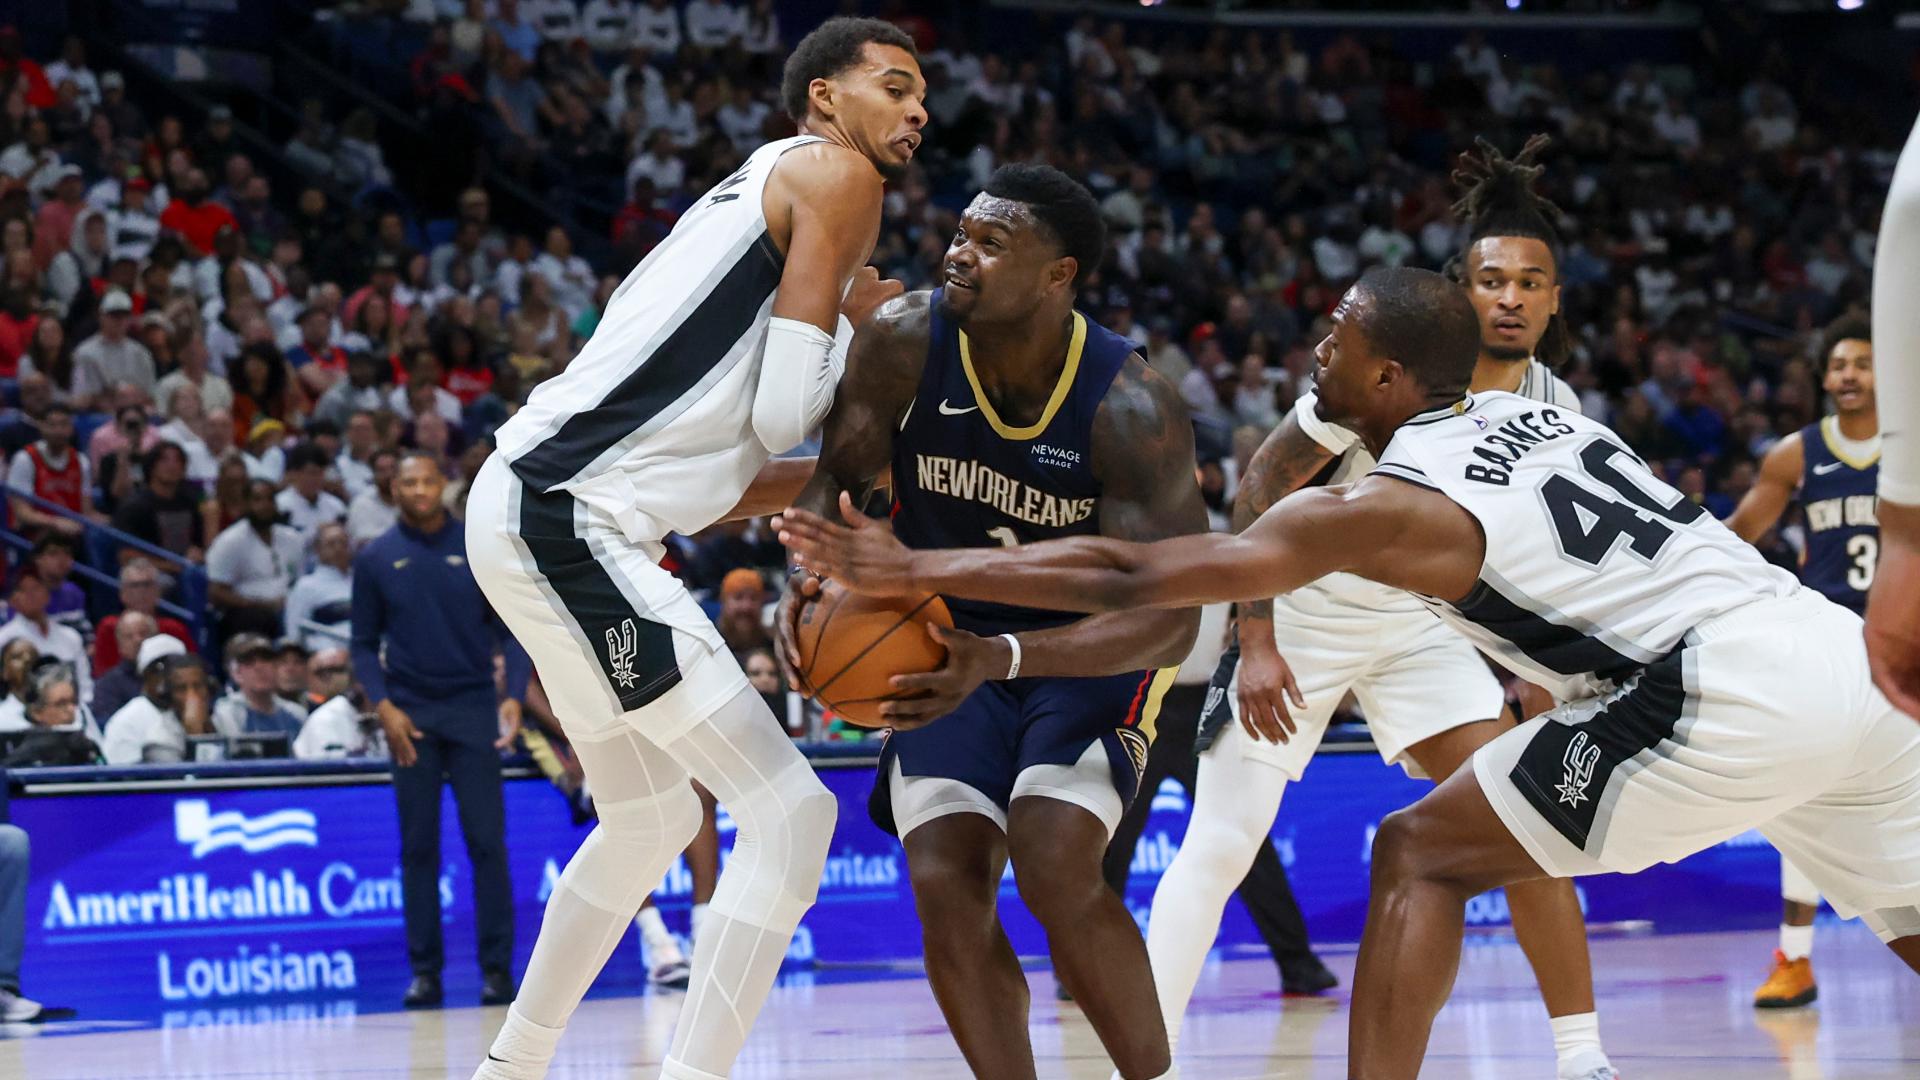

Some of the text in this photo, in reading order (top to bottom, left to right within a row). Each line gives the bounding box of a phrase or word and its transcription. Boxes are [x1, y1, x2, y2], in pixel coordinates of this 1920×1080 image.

[1030, 444, 1081, 464] NEWAGE
[1038, 456, 1072, 470] GARAGE
[1535, 433, 1706, 571] 40
[1847, 534, 1878, 591] 3
[42, 860, 454, 930] AmeriHealth Caris
[157, 943, 357, 999] Louisiana
